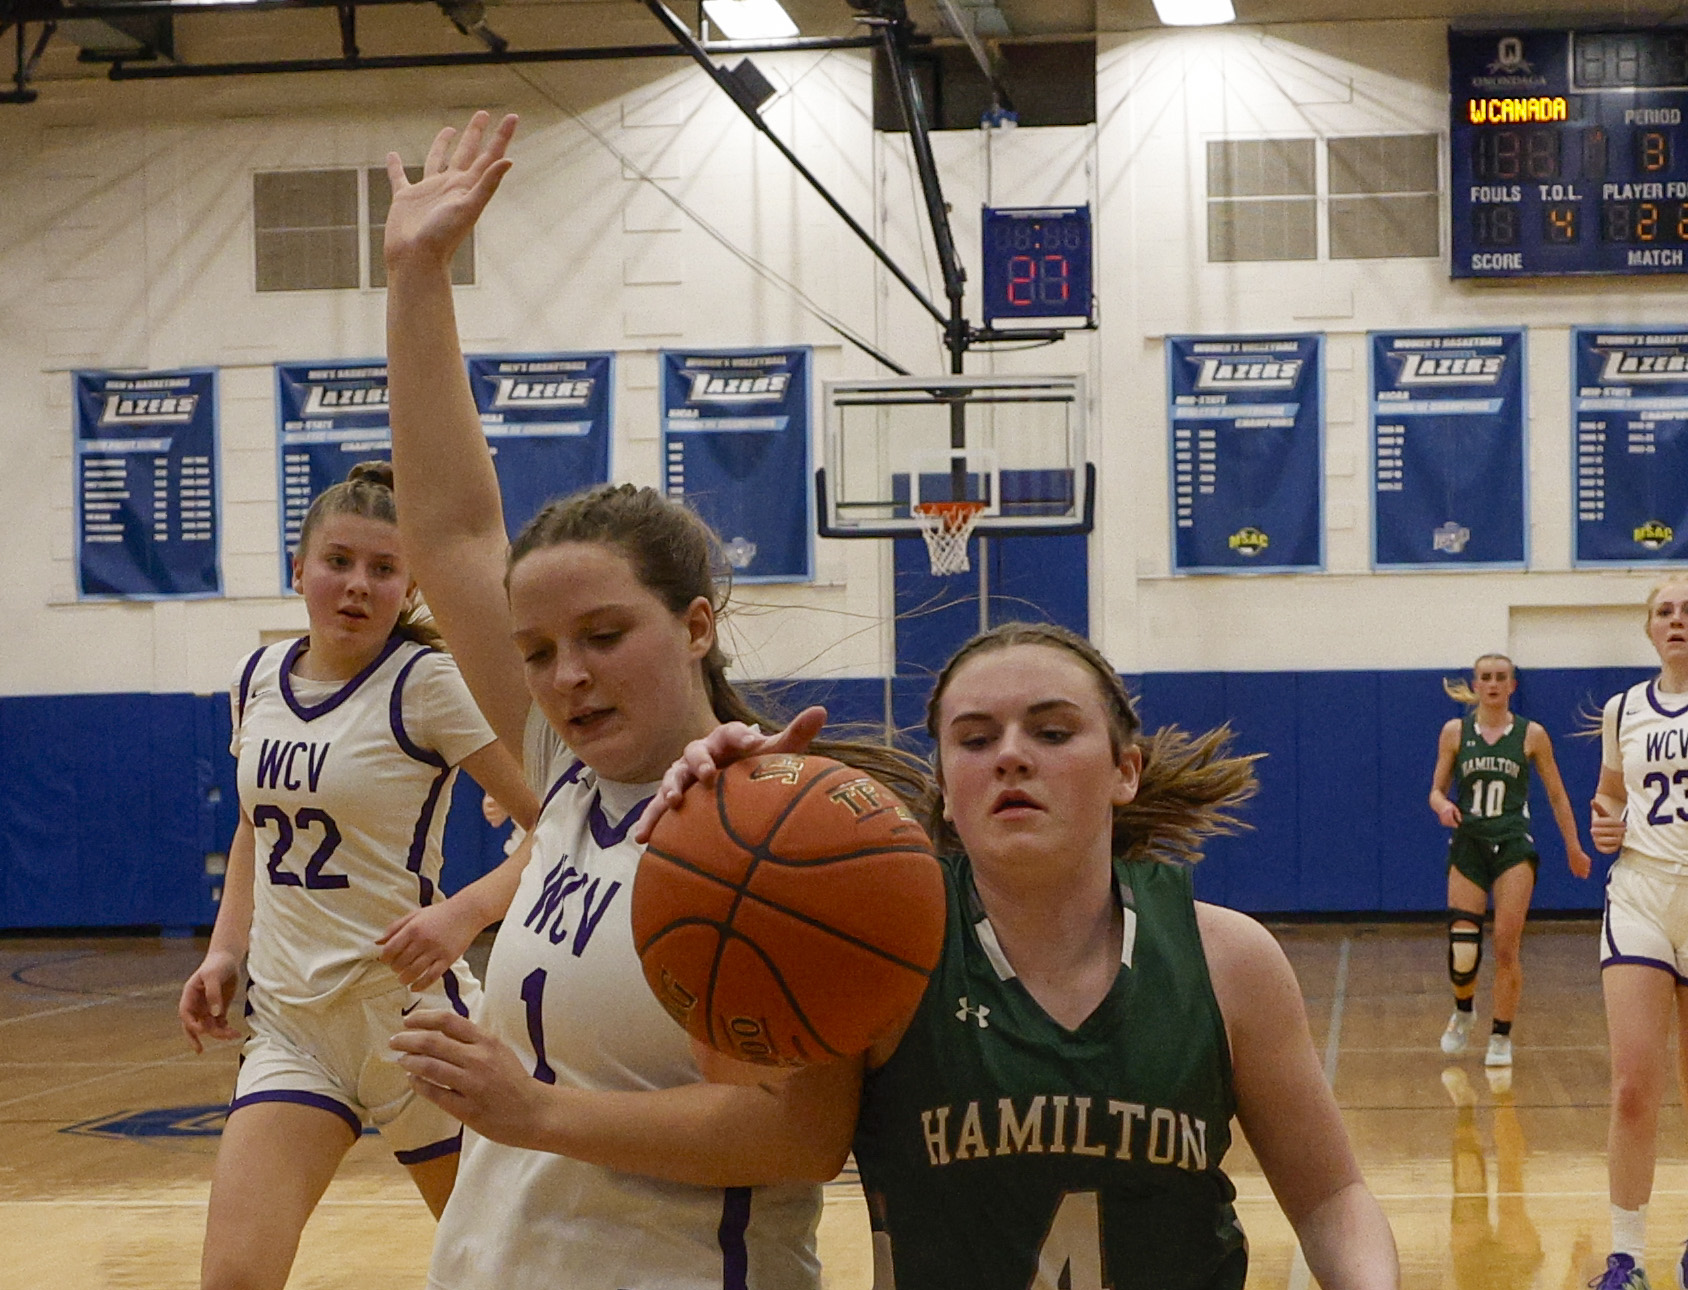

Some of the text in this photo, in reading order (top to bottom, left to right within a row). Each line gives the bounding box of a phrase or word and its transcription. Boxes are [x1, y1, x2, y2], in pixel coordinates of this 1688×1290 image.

[1469, 97, 1568, 123] WCANADA
[1625, 109, 1681, 125] PERIOD
[1471, 182, 1688, 203] FOULS T.O.L. PLAYER FO
[1550, 209, 1573, 238] 4
[1472, 253, 1523, 270] SCORE
[1628, 250, 1683, 266] MATCH
[1006, 254, 1069, 306] 27
[1198, 359, 1299, 388] LAZERS
[1400, 354, 1502, 384] LAZERS
[1603, 351, 1688, 380] LAZER
[494, 378, 591, 406] LAZERS
[690, 373, 787, 401] LAZERS
[103, 394, 195, 423] LAZERS
[257, 738, 330, 793] WCV
[1462, 756, 1520, 779] HAMILTON
[1471, 779, 1506, 817] 10
[253, 804, 350, 890] 22
[520, 967, 556, 1085] 1
[921, 1096, 1208, 1171] HAMILTON
